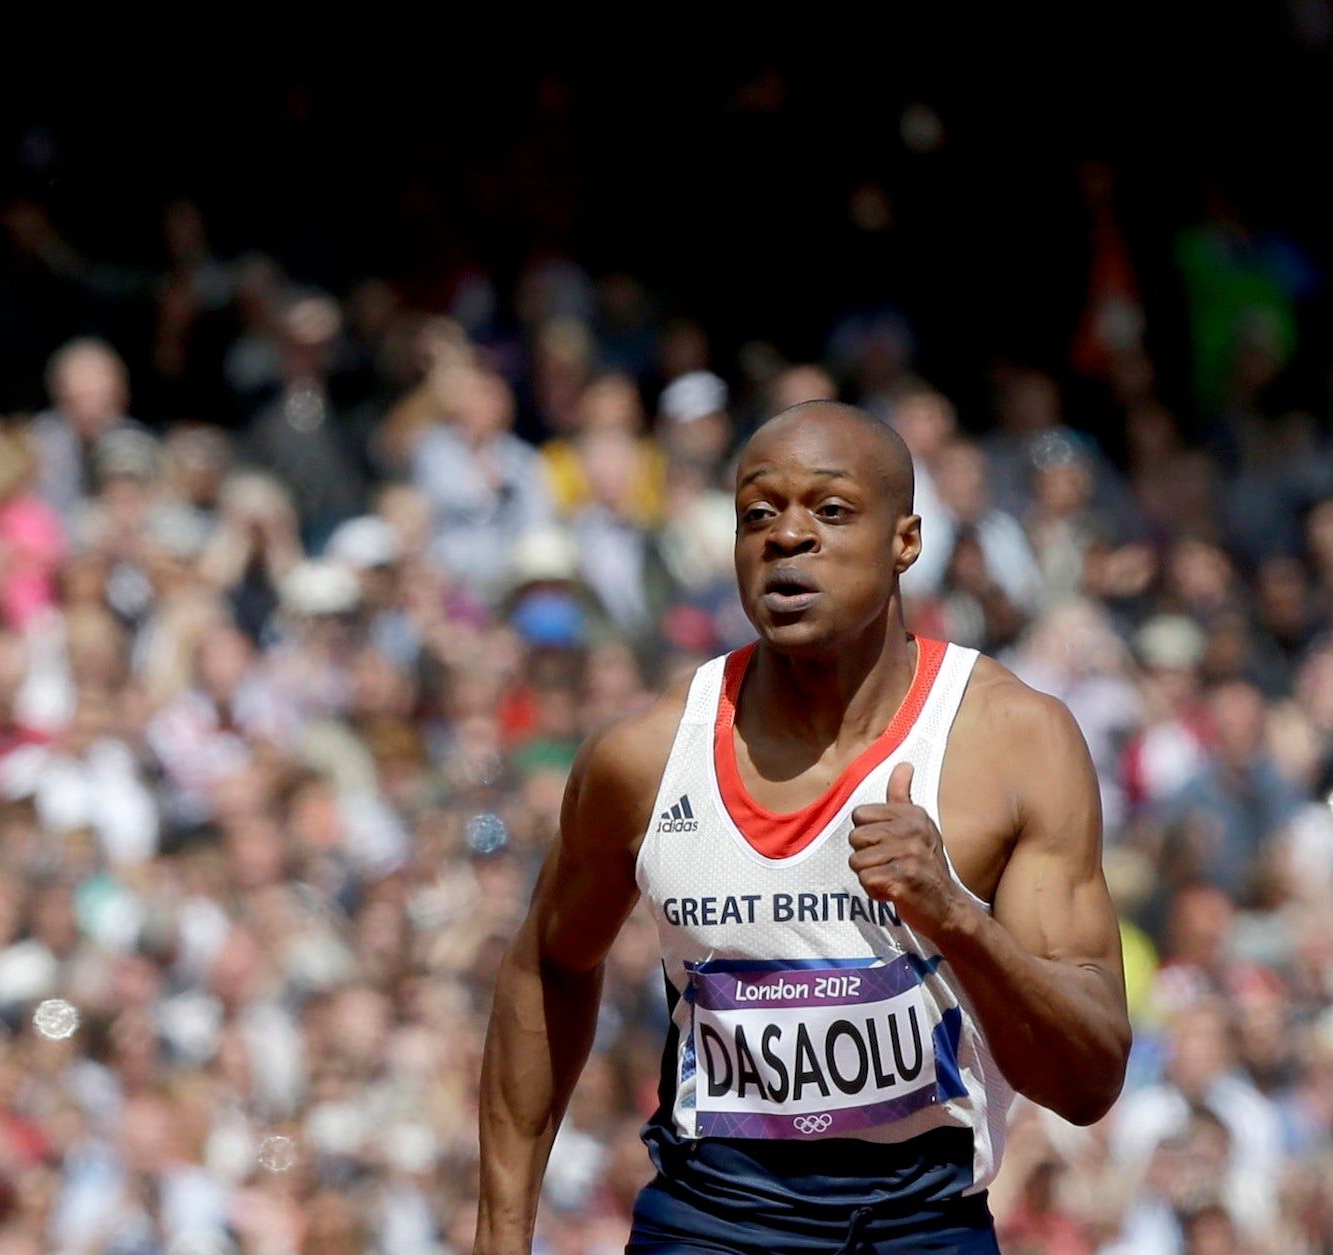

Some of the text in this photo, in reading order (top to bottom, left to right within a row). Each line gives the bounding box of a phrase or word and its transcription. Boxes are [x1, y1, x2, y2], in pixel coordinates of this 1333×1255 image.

[663, 893, 902, 927] GREAT BRITAIN
[735, 976, 862, 1002] London 2012
[699, 1006, 923, 1104] DASAOLU
